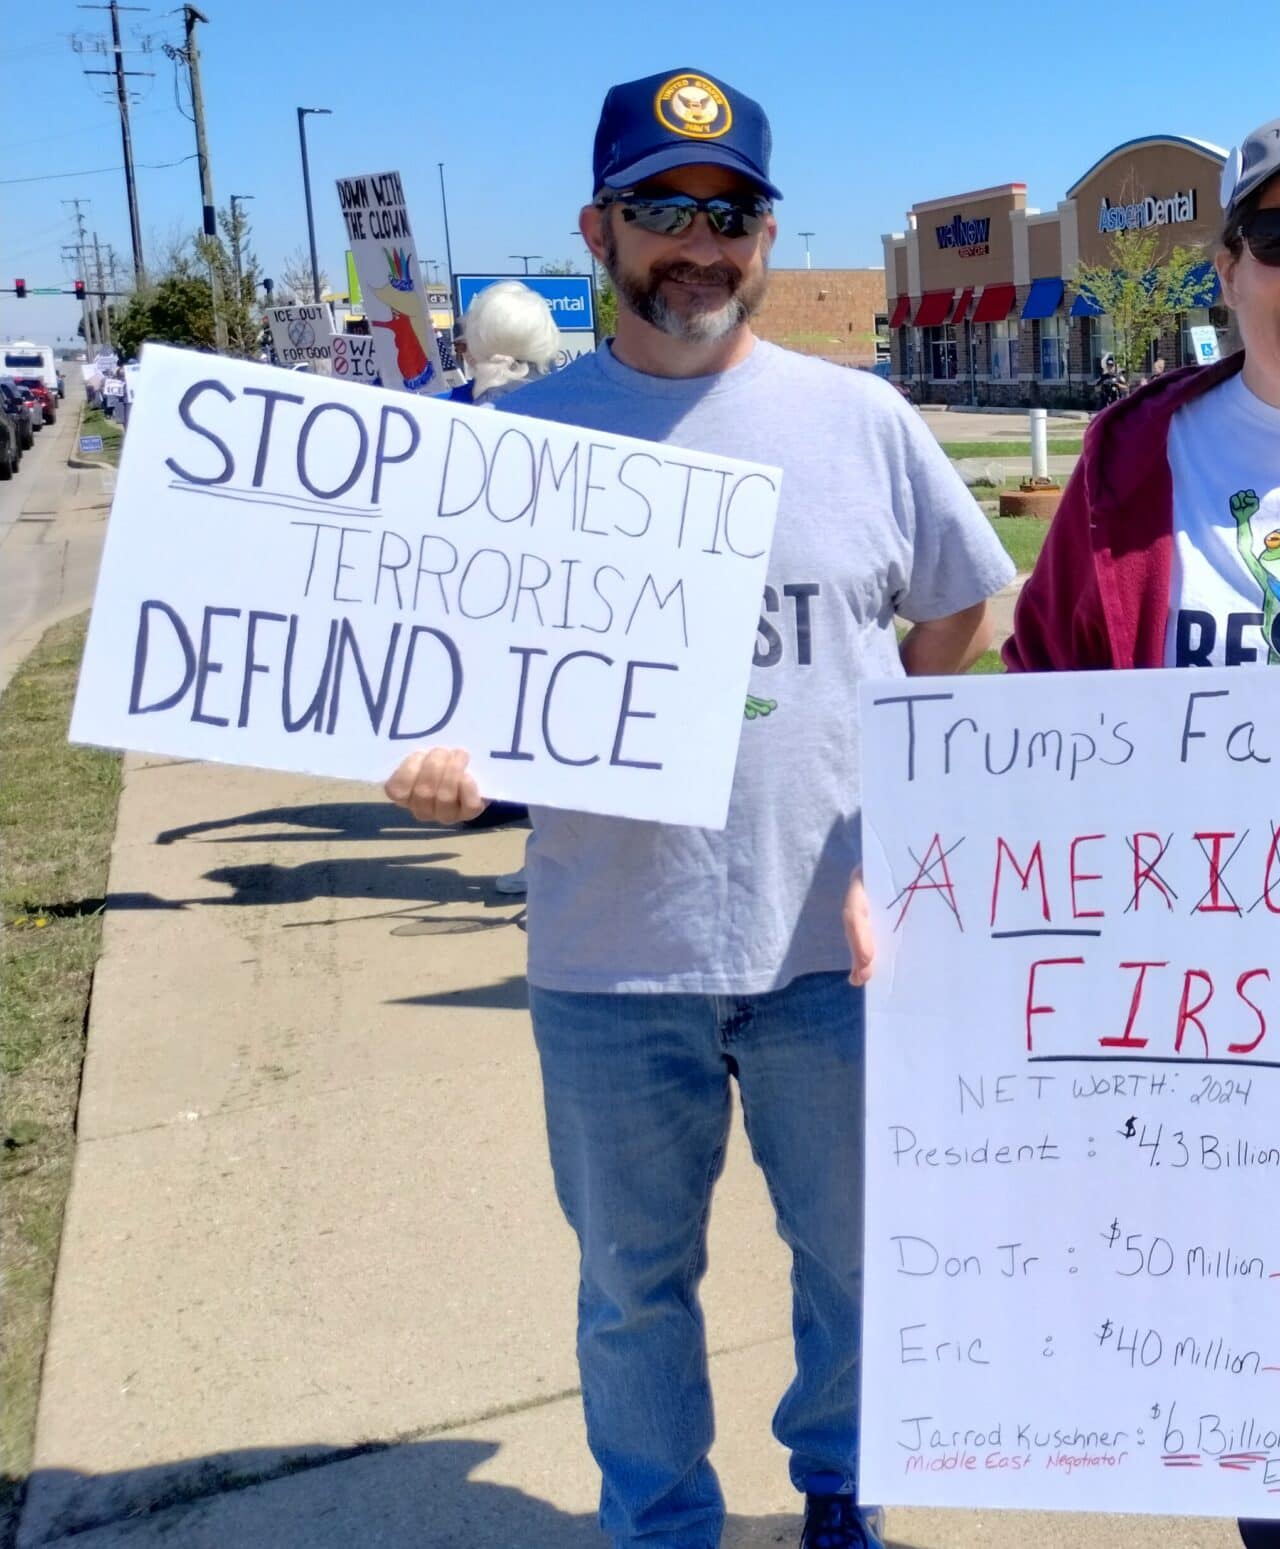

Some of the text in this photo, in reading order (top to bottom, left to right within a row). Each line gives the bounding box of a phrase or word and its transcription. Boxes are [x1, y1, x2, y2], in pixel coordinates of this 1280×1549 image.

[336, 173, 405, 209] DOWN WITH
[343, 209, 412, 241] THE CLOWN
[274, 307, 323, 322] ICE OUT
[283, 346, 305, 361] FOR
[351, 358, 380, 377] IC
[165, 380, 776, 559] STOP DOMESTIC
[290, 521, 688, 647] TERRORISM
[128, 599, 679, 771] DEFUND ICE
[874, 693, 1135, 781] Trump's
[957, 1073, 1057, 1115] NET
[1190, 1075, 1253, 1105] 2024
[1199, 1134, 1280, 1170] Billion
[889, 1235, 982, 1278] Don
[996, 1243, 1039, 1278] Jr
[1099, 1217, 1175, 1277] $50
[899, 1323, 991, 1365] Eric
[1093, 1318, 1163, 1368] $40
[896, 1416, 1002, 1452] Jarrod
[1151, 1400, 1185, 1454] $6
[984, 1451, 1031, 1471] East
[1045, 1451, 1129, 1475] Negotiator
